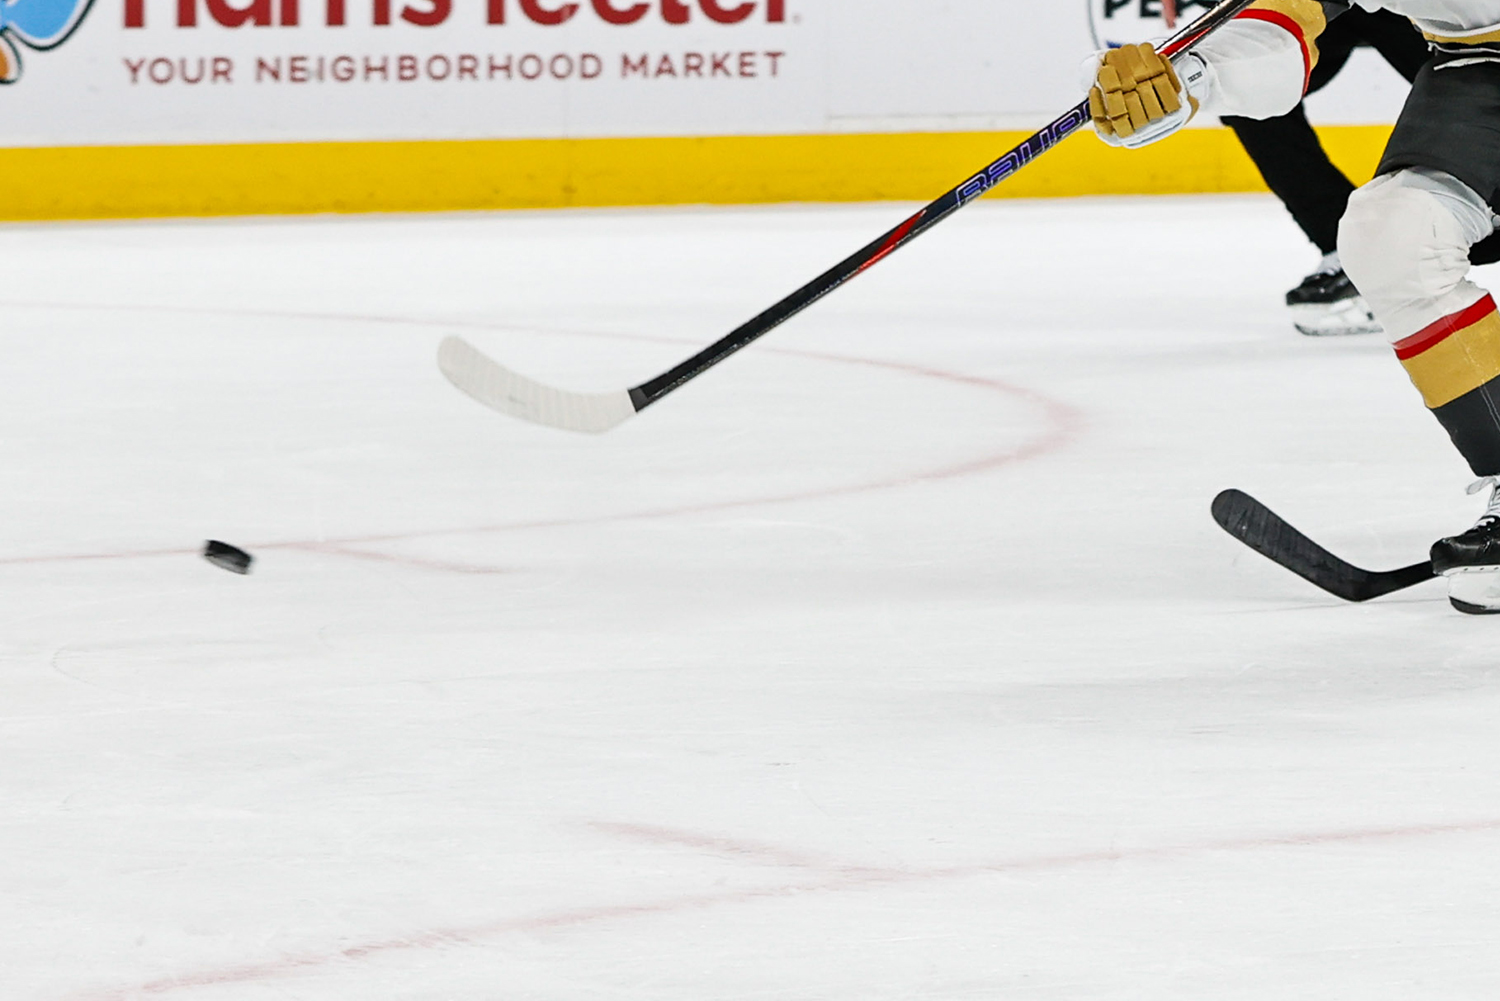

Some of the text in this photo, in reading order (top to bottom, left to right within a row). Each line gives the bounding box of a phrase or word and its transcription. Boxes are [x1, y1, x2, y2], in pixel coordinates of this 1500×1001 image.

[124, 50, 786, 86] YOUR NEIGHBORHOOD MARKET
